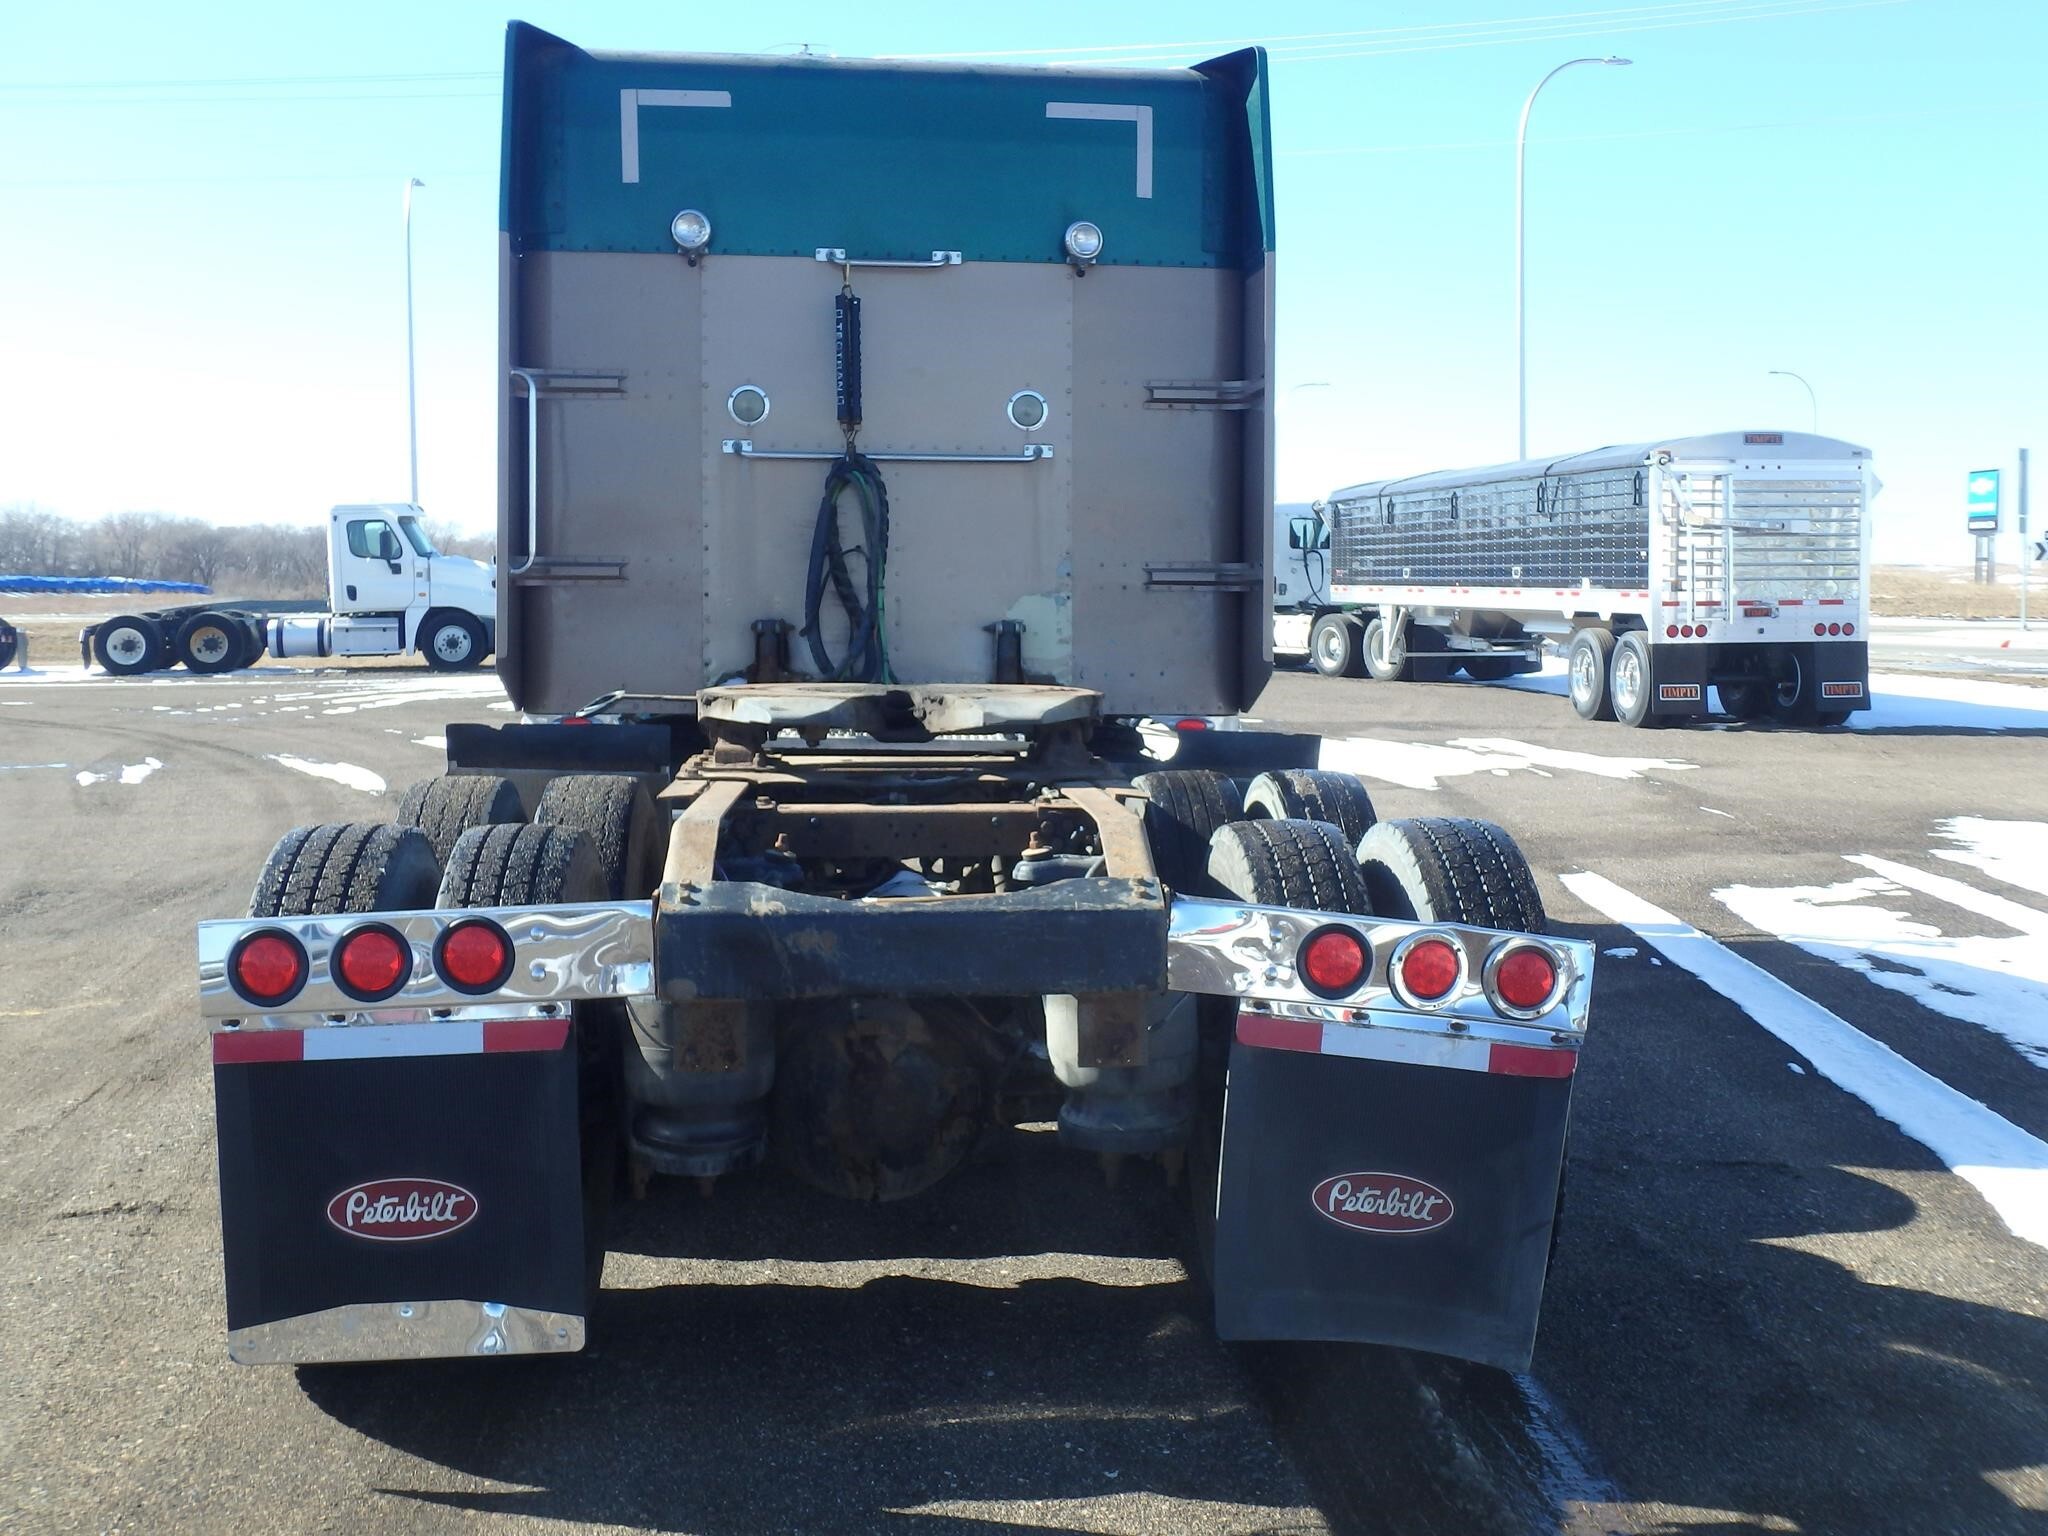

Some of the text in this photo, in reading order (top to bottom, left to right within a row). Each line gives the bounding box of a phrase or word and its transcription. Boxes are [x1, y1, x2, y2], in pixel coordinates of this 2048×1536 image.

[1662, 687, 1697, 698] TIMPTE
[1824, 684, 1860, 695] TIMPTE
[346, 1191, 465, 1227] Peterbilt
[1328, 1179, 1443, 1221] Peterbilt
